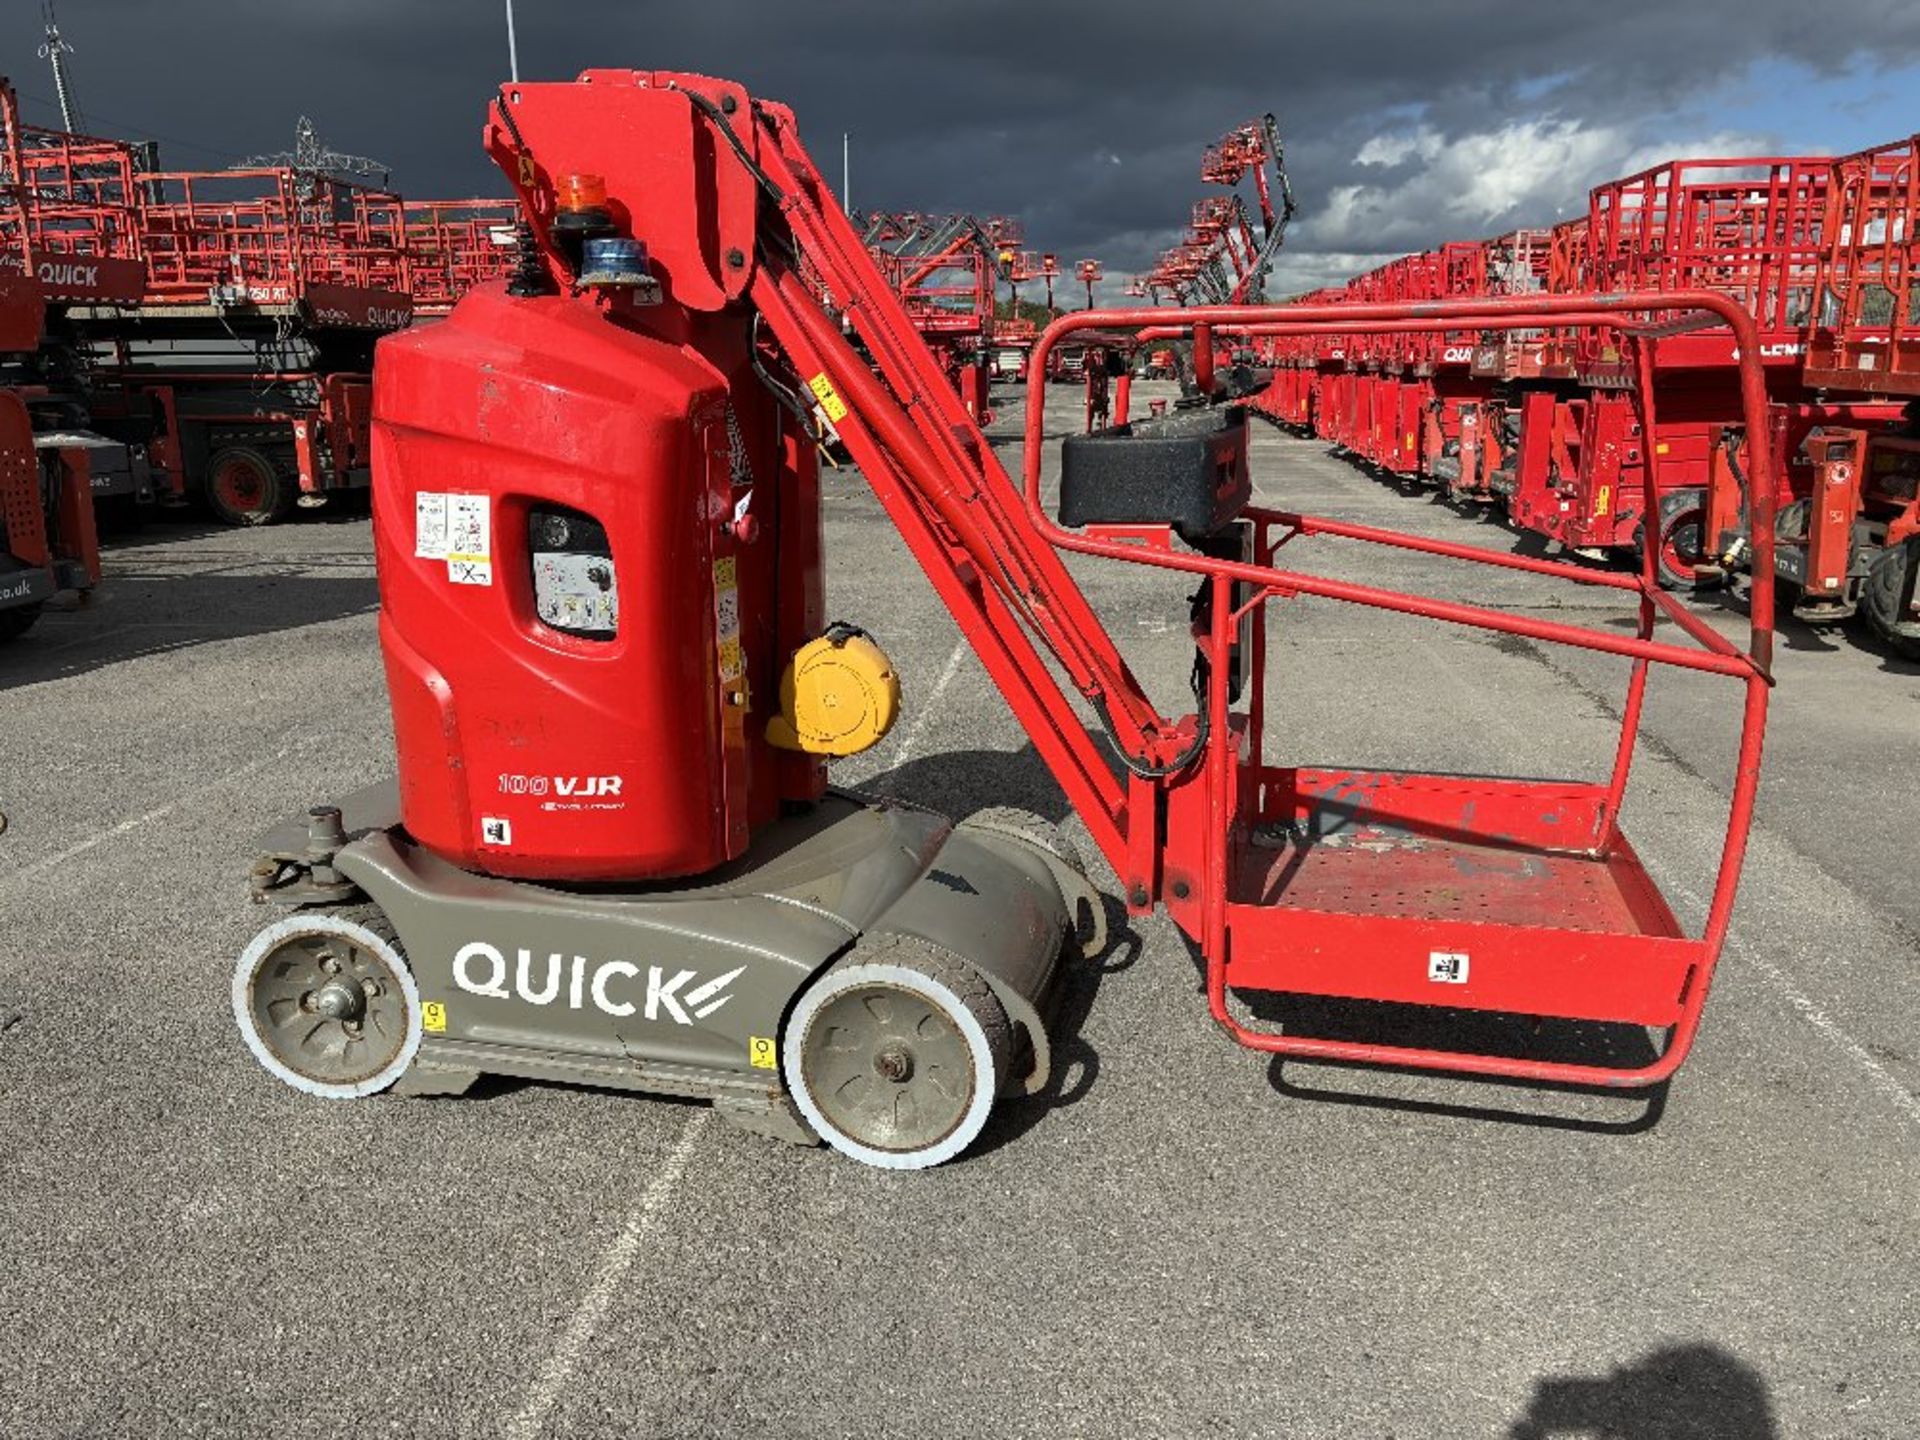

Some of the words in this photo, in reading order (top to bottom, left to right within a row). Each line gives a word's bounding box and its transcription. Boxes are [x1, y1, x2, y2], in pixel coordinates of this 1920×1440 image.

[38, 262, 98, 287] QUICK
[367, 306, 406, 326] QUICK
[498, 773, 549, 796] 100
[554, 775, 623, 796] VJR
[452, 941, 697, 1026] QUICK
